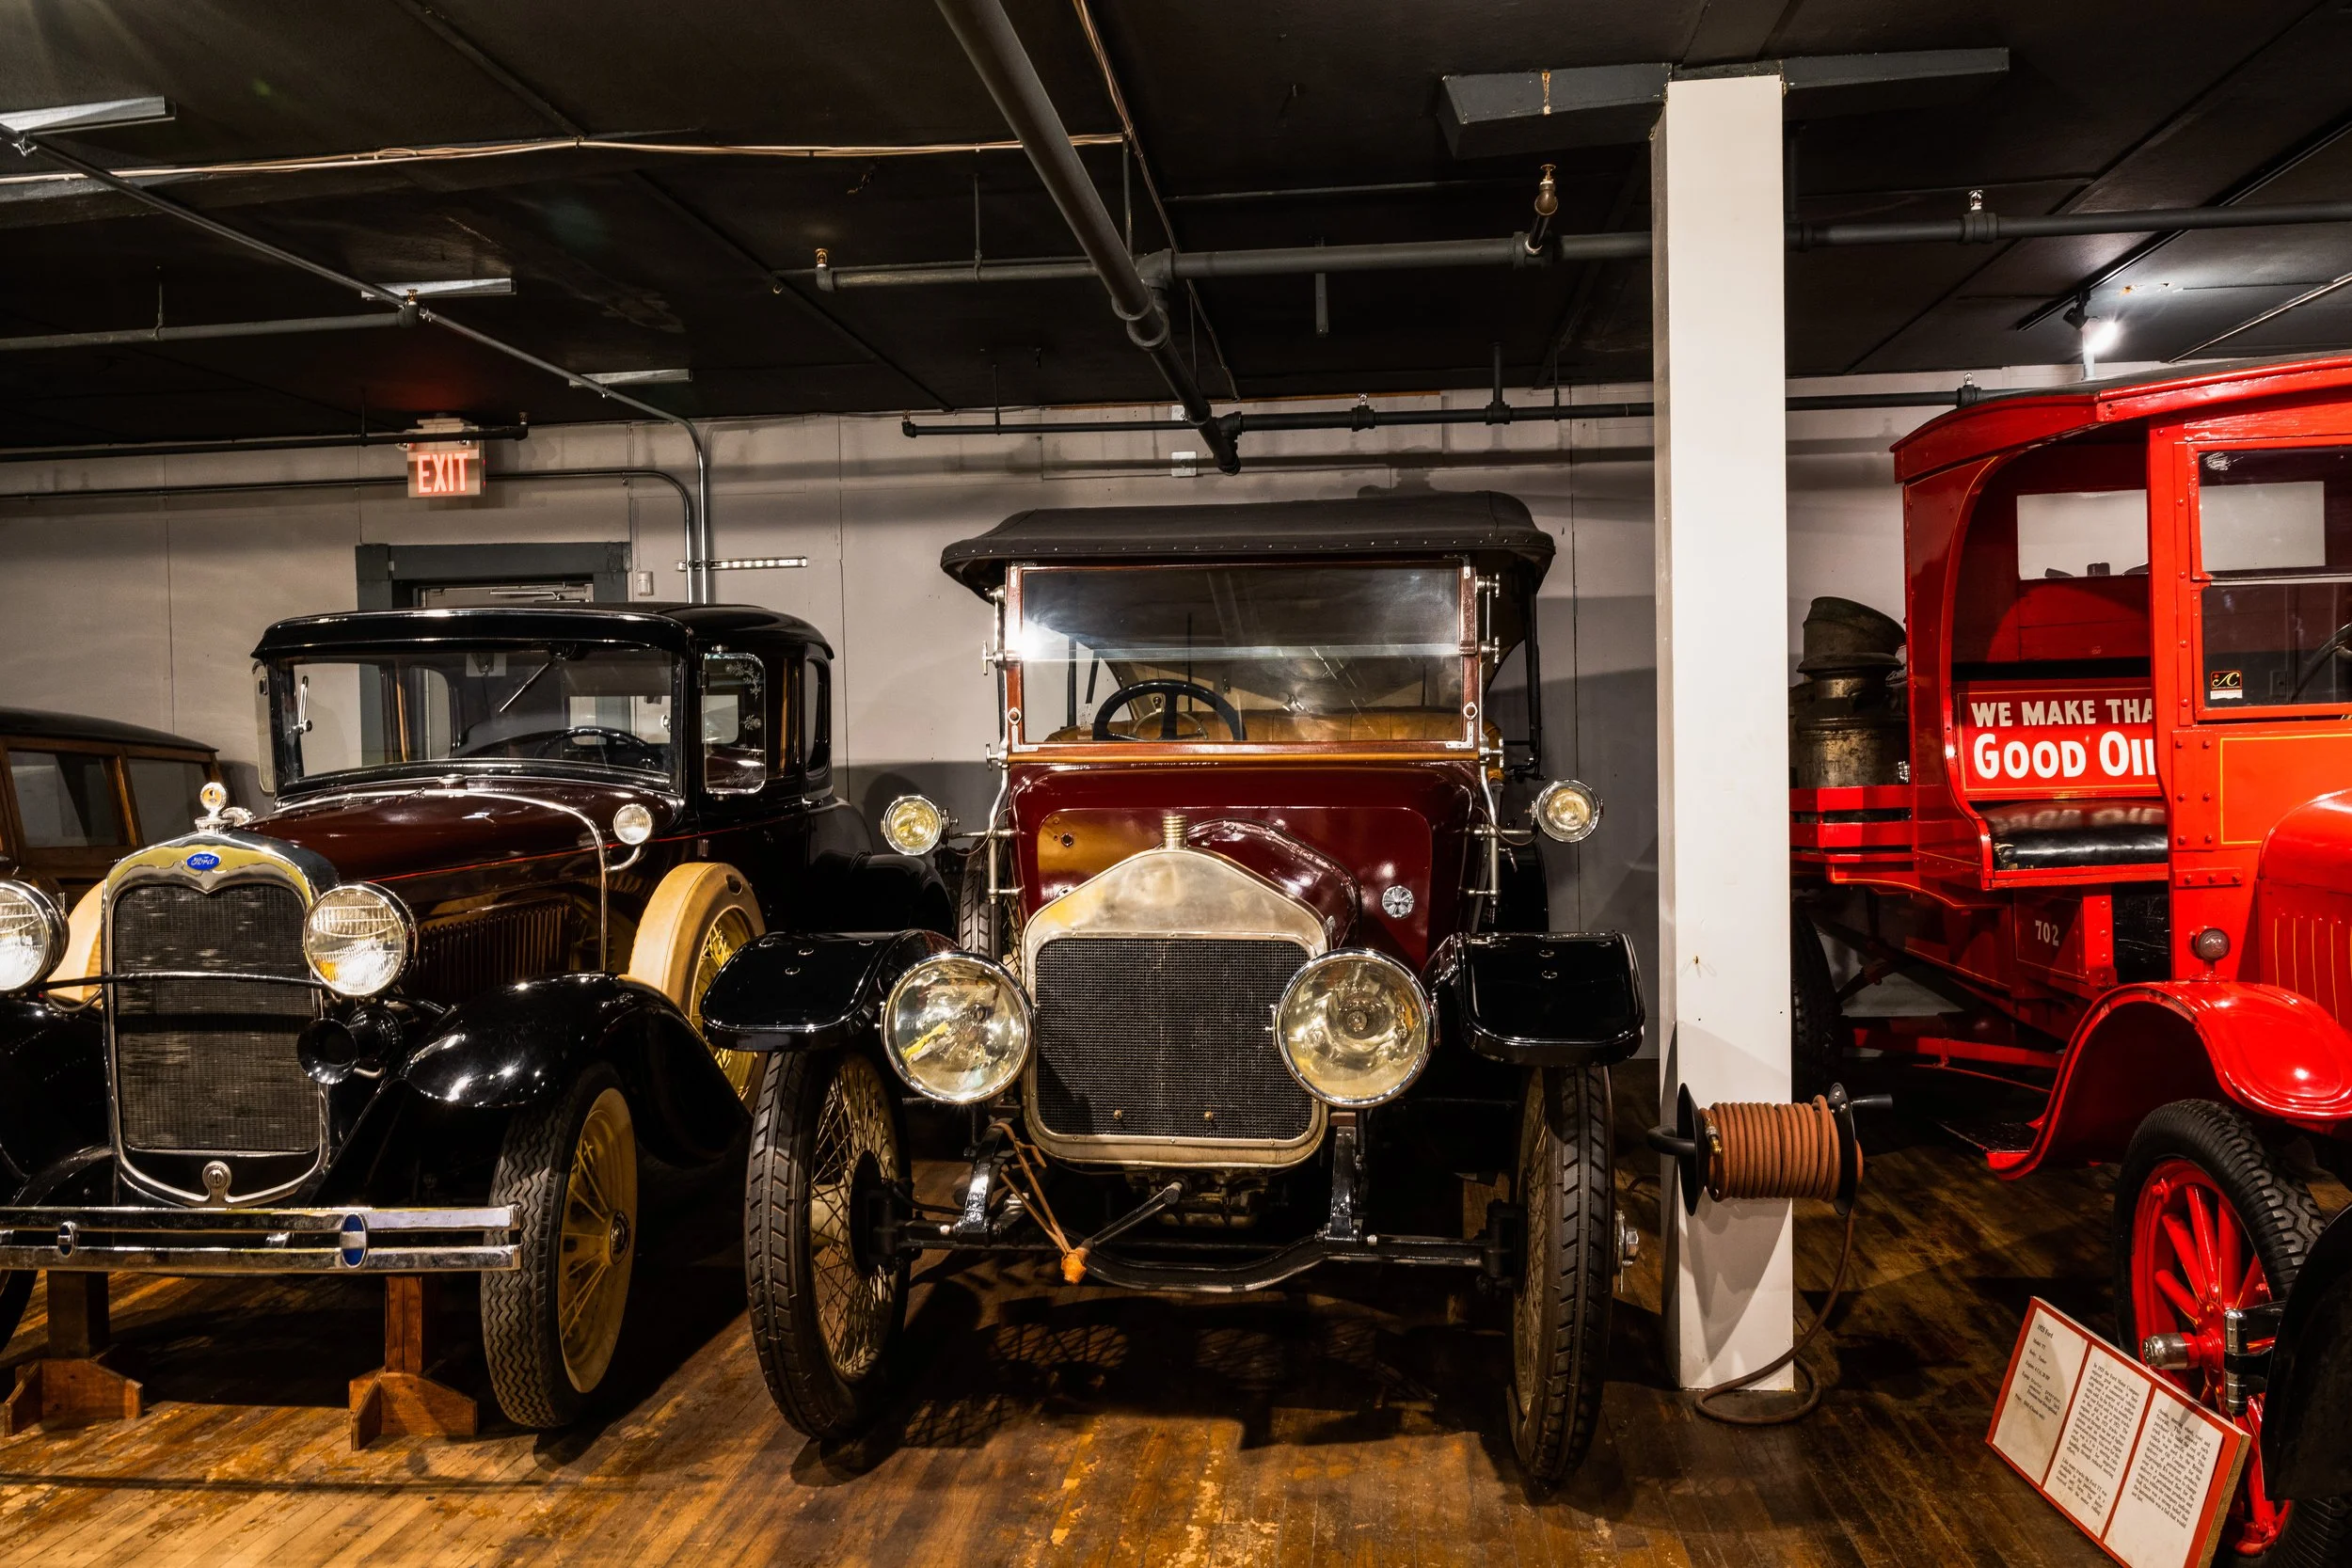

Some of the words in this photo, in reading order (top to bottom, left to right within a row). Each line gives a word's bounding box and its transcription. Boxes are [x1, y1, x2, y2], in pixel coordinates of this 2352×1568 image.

[417, 452, 469, 494] EXIT
[1971, 703, 2012, 727] WE
[2022, 700, 2096, 726] MAKE
[1973, 733, 2087, 779] GOOD
[191, 857, 215, 865] Ford
[2035, 920, 2059, 946] 702
